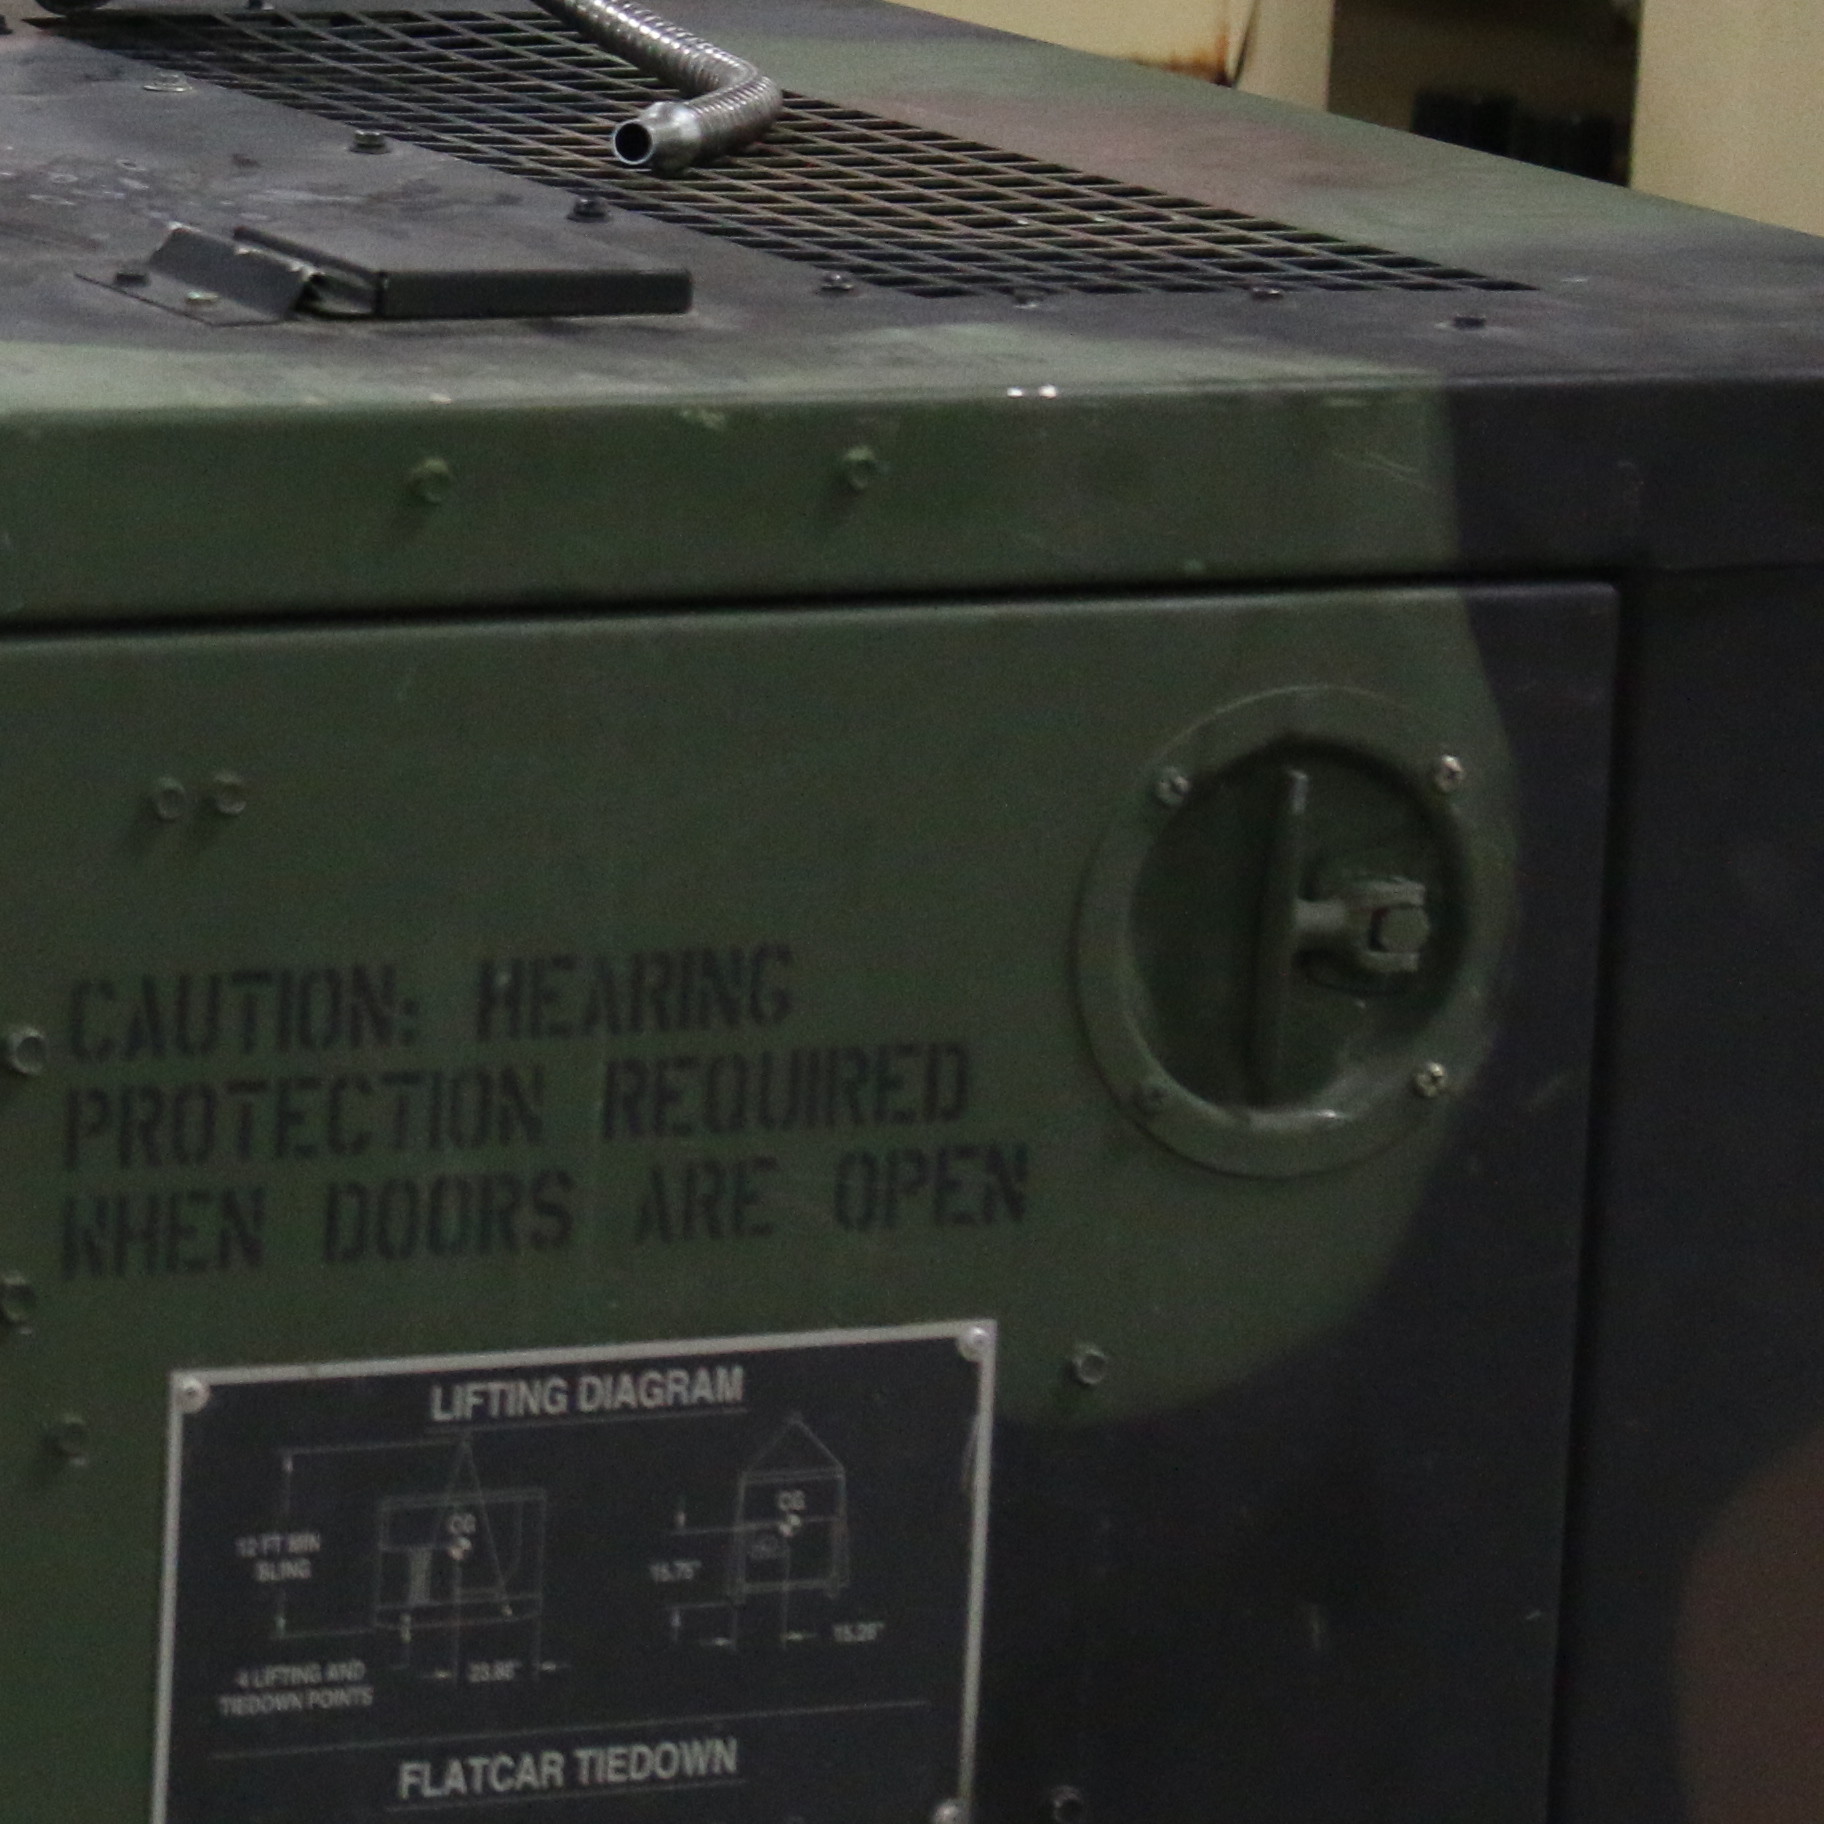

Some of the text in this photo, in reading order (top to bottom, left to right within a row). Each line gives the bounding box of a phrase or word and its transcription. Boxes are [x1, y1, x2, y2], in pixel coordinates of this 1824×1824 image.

[66, 942, 794, 1065] CAUTION: HEARING
[63, 1037, 976, 1172] PROTECTION REQUIRED
[60, 1141, 1030, 1282] WHEN DOORS ARE OPEN
[430, 1364, 747, 1424] LIFTING DIAGRAM
[398, 1738, 740, 1802] FLATCAR TIEDOWN
